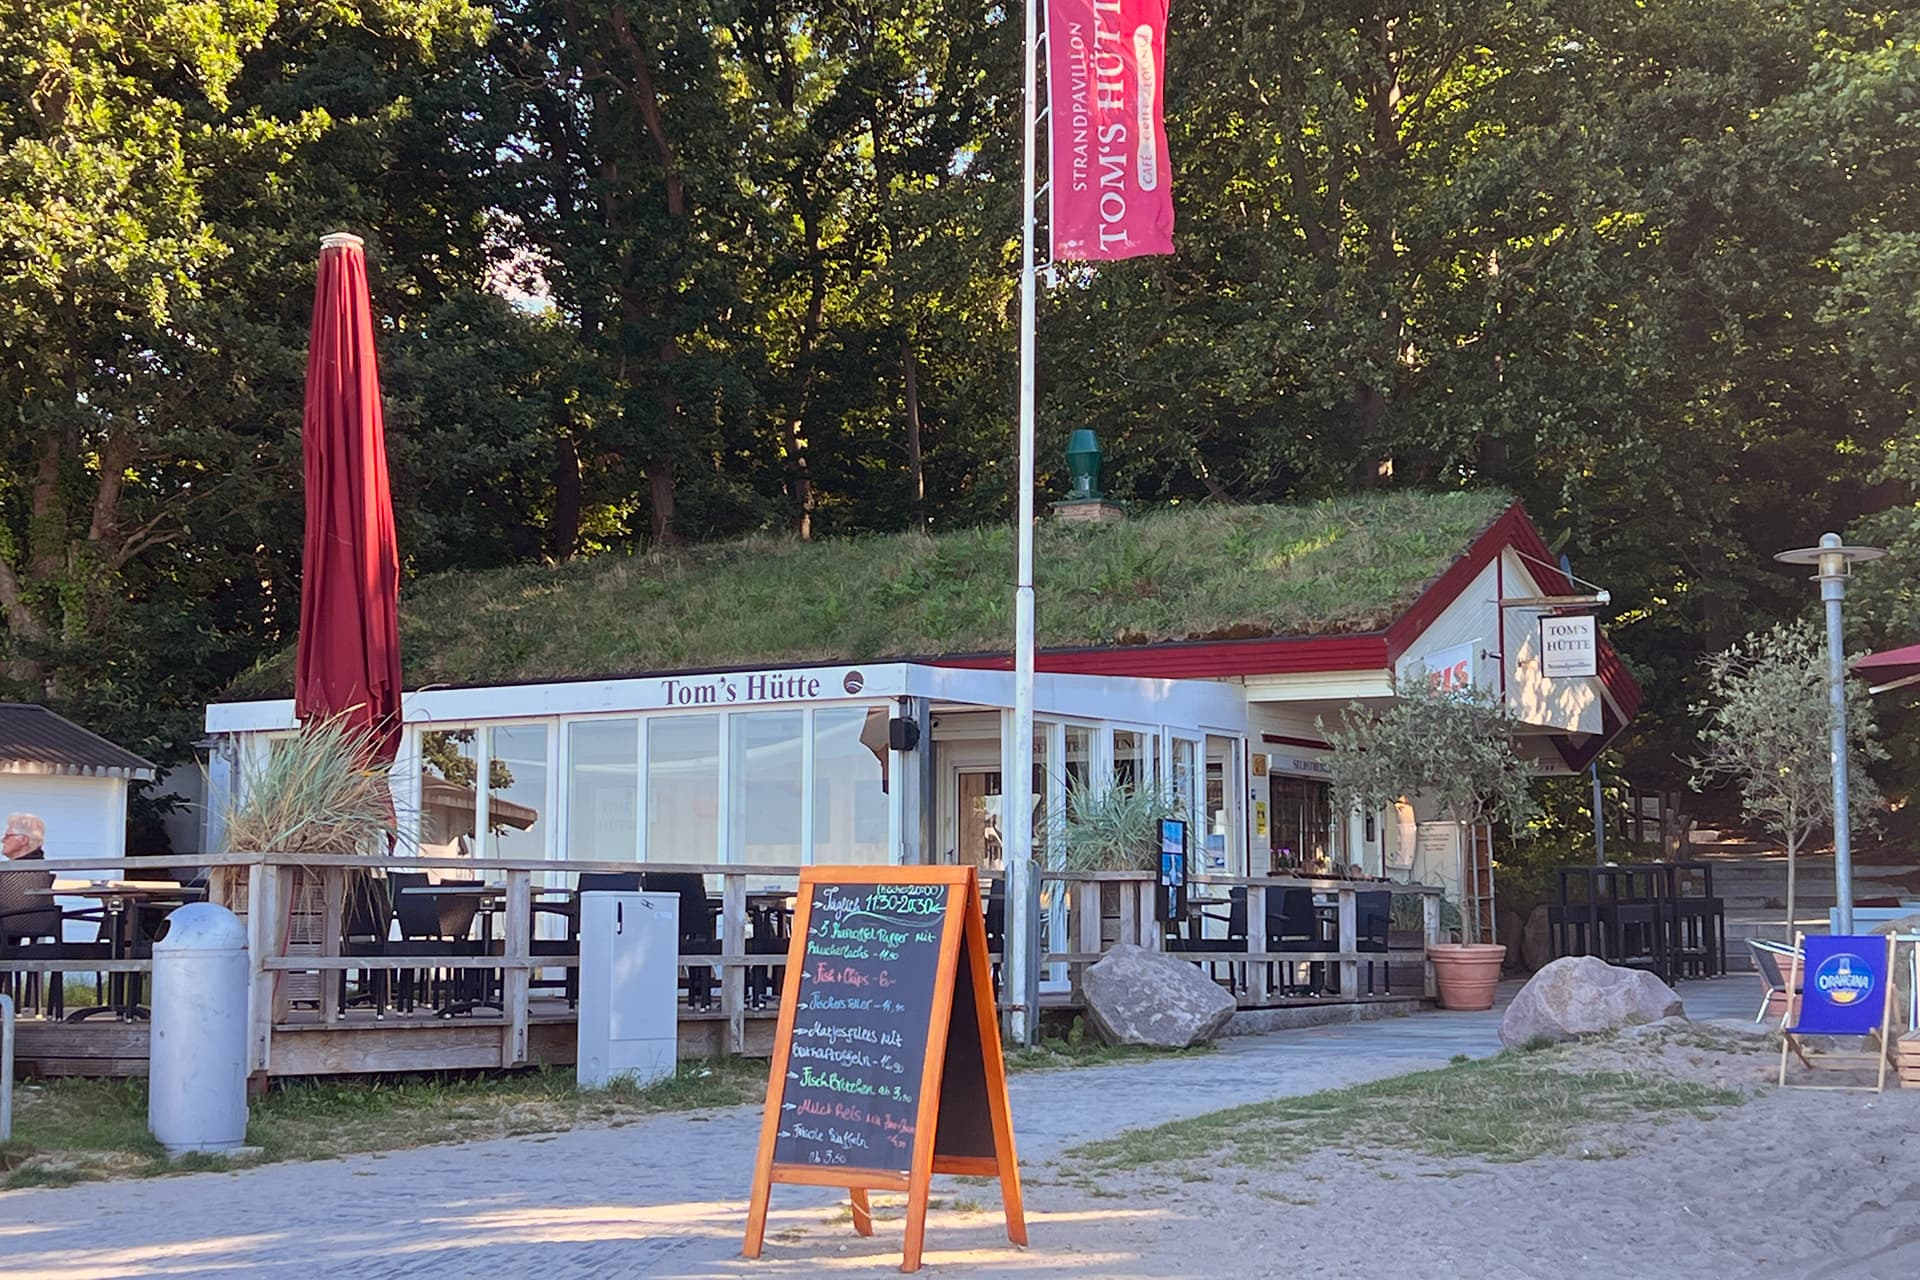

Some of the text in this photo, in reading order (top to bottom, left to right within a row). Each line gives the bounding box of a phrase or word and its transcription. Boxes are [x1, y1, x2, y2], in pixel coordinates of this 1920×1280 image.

[1069, 22, 1088, 192] STRANDPAVILLON
[1140, 153, 1154, 185] CAFÉ
[1547, 624, 1588, 637] TOM'S
[1547, 638, 1591, 652] HÜTTE
[662, 673, 820, 706] Tom's Hütte
[1429, 658, 1469, 697] EIS
[1819, 974, 1869, 990] ORANGINA
